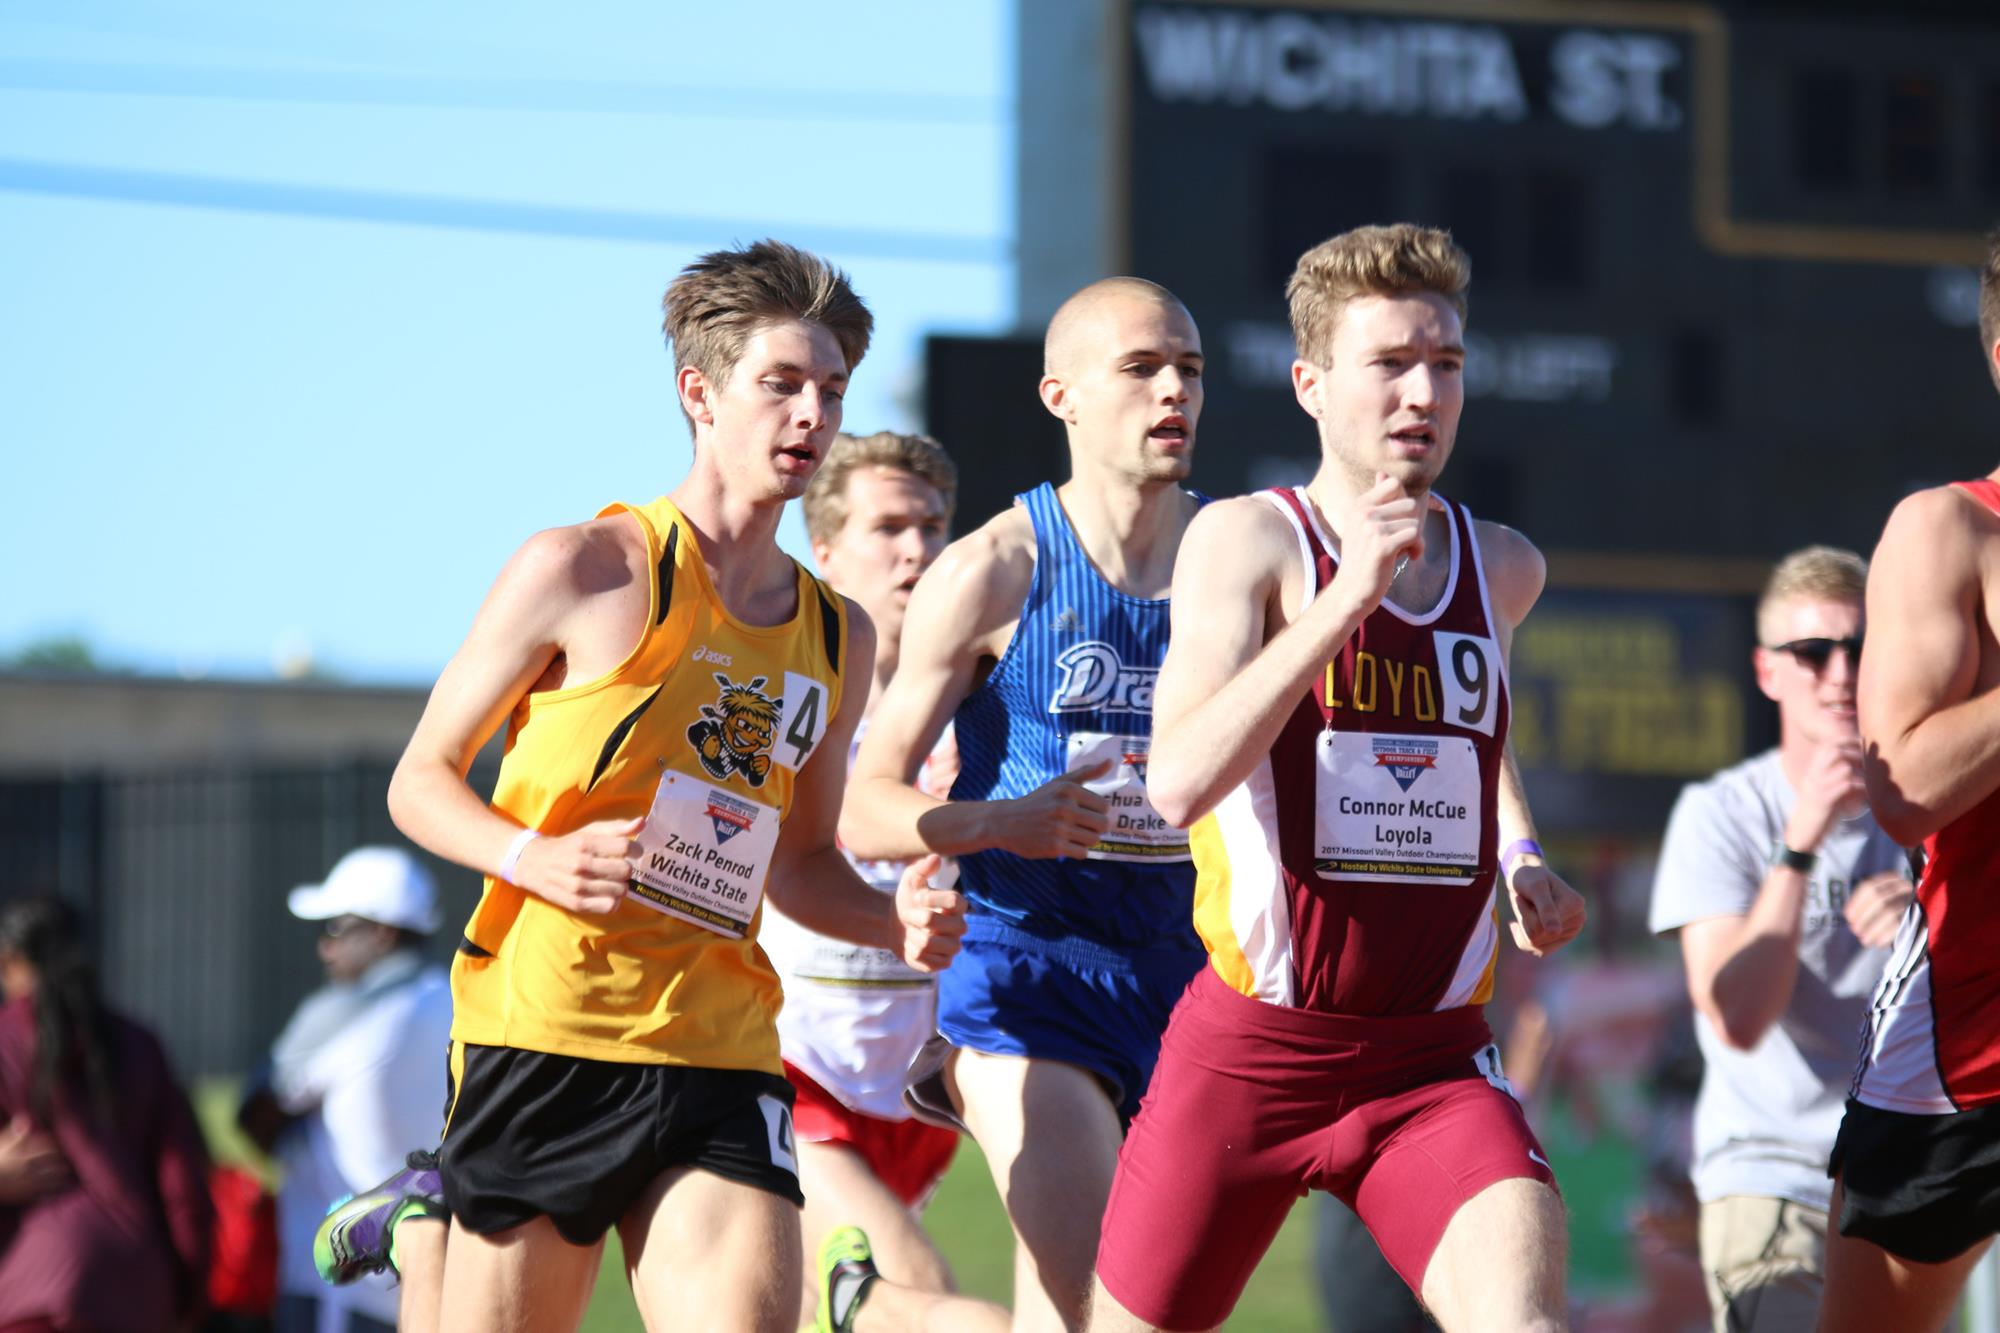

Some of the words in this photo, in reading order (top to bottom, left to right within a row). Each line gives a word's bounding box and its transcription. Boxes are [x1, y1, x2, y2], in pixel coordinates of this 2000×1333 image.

[1133, 13, 1526, 119] WICHITA
[1550, 31, 1682, 129] ST.
[705, 651, 732, 667] asics
[1048, 640, 1160, 714] Dra
[1325, 651, 1437, 721] LOYO
[1452, 639, 1489, 725] 9
[785, 686, 820, 766] 4
[719, 748, 733, 773] WSU
[1339, 796, 1405, 816] Connor
[1409, 799, 1466, 820] McCue
[1116, 814, 1167, 830] Drake
[1375, 824, 1432, 848] Loyola
[665, 833, 703, 861] Zack
[704, 848, 755, 880] Penrod
[1321, 846, 1340, 855] 2017
[1342, 847, 1374, 856] Missouri
[1375, 848, 1396, 859] Valley
[1396, 849, 1424, 859] Outdoor
[1425, 850, 1477, 863] Championships
[650, 853, 710, 890] Wichita
[711, 878, 748, 904] State
[1340, 862, 1368, 871] Hosted
[1369, 863, 1379, 874] by
[1379, 863, 1404, 873] Wichita
[1405, 865, 1425, 874] State
[1426, 866, 1463, 877] University
[644, 872, 672, 889] Missouri
[672, 883, 691, 898] Valley
